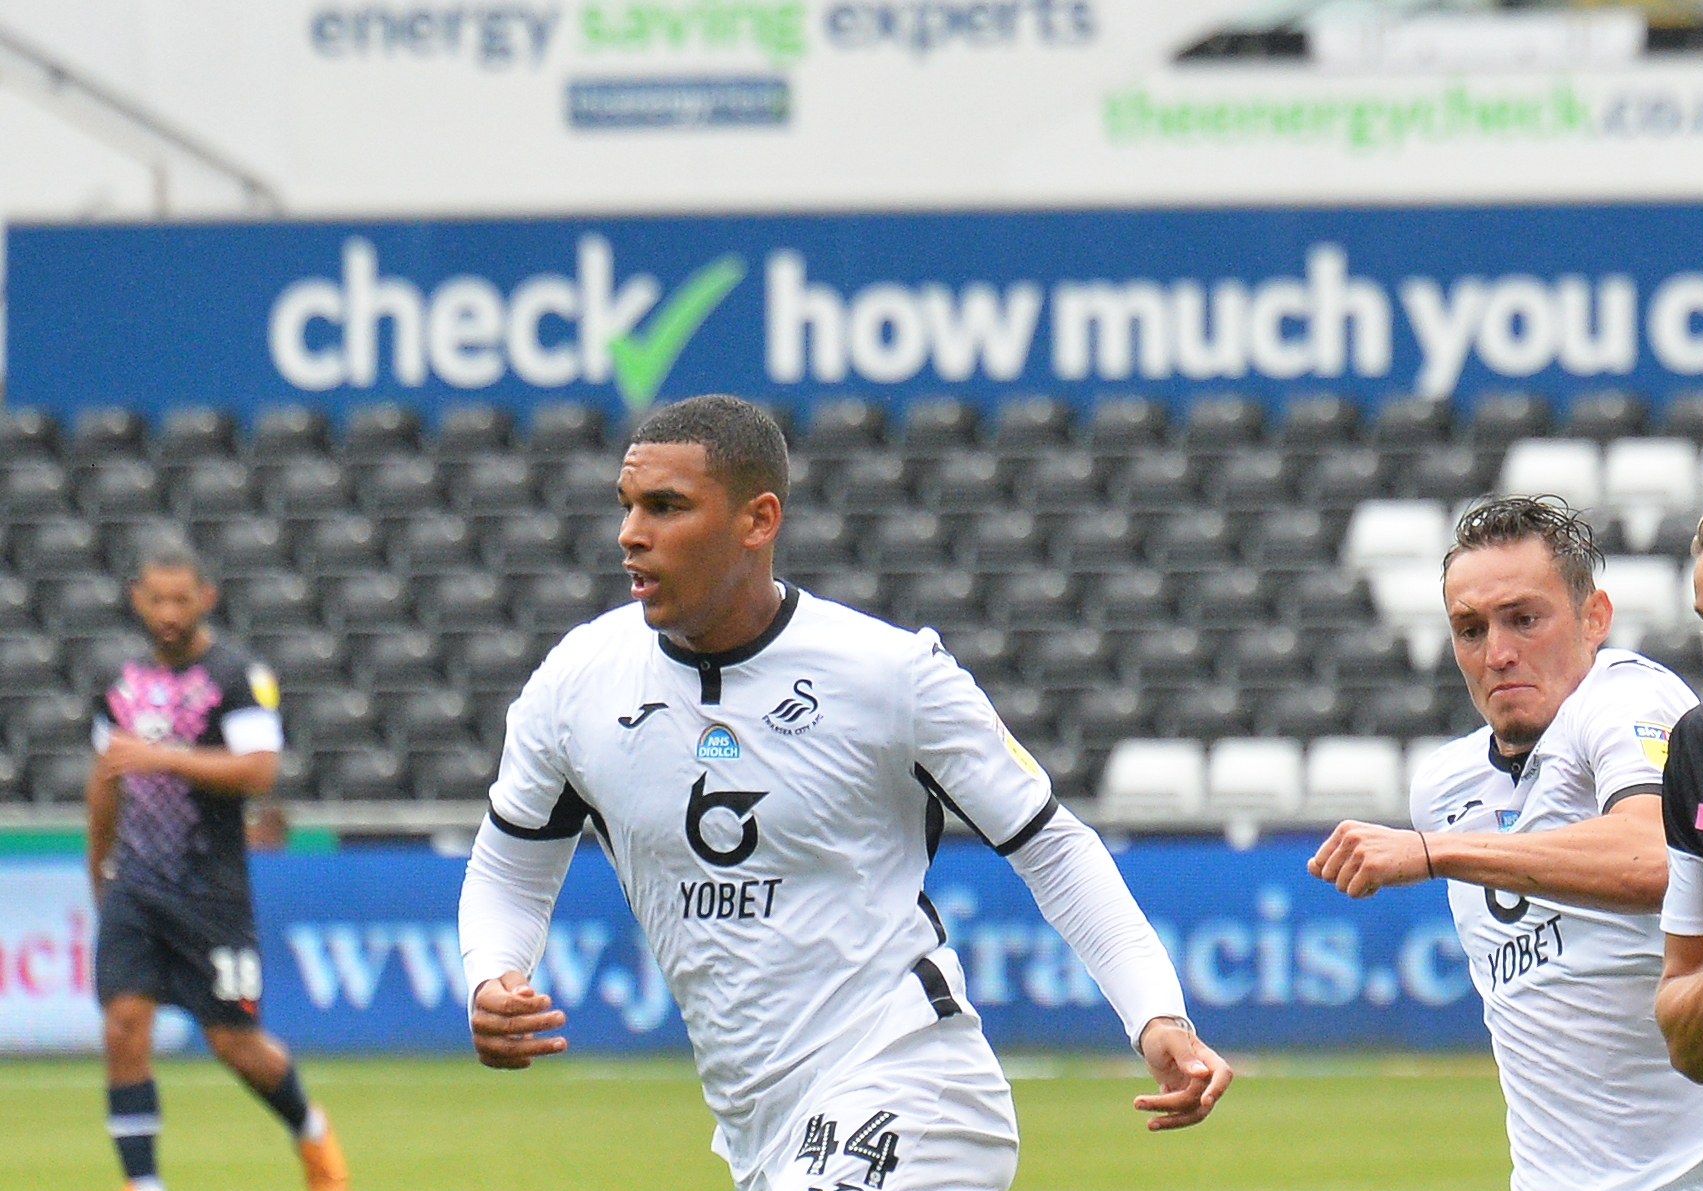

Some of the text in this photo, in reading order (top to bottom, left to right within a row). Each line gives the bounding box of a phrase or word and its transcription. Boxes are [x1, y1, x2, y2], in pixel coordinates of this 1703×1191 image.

[309, 0, 1094, 67] energy saving experts
[266, 234, 661, 390] check
[764, 248, 1042, 384] how
[1051, 244, 1393, 381] much
[1402, 272, 1636, 403] you
[698, 747, 738, 757] DIOLCH
[708, 736, 730, 746] NHS
[680, 878, 783, 919] YOBET
[1487, 913, 1564, 993] YOBET
[795, 1110, 899, 1190] 44
